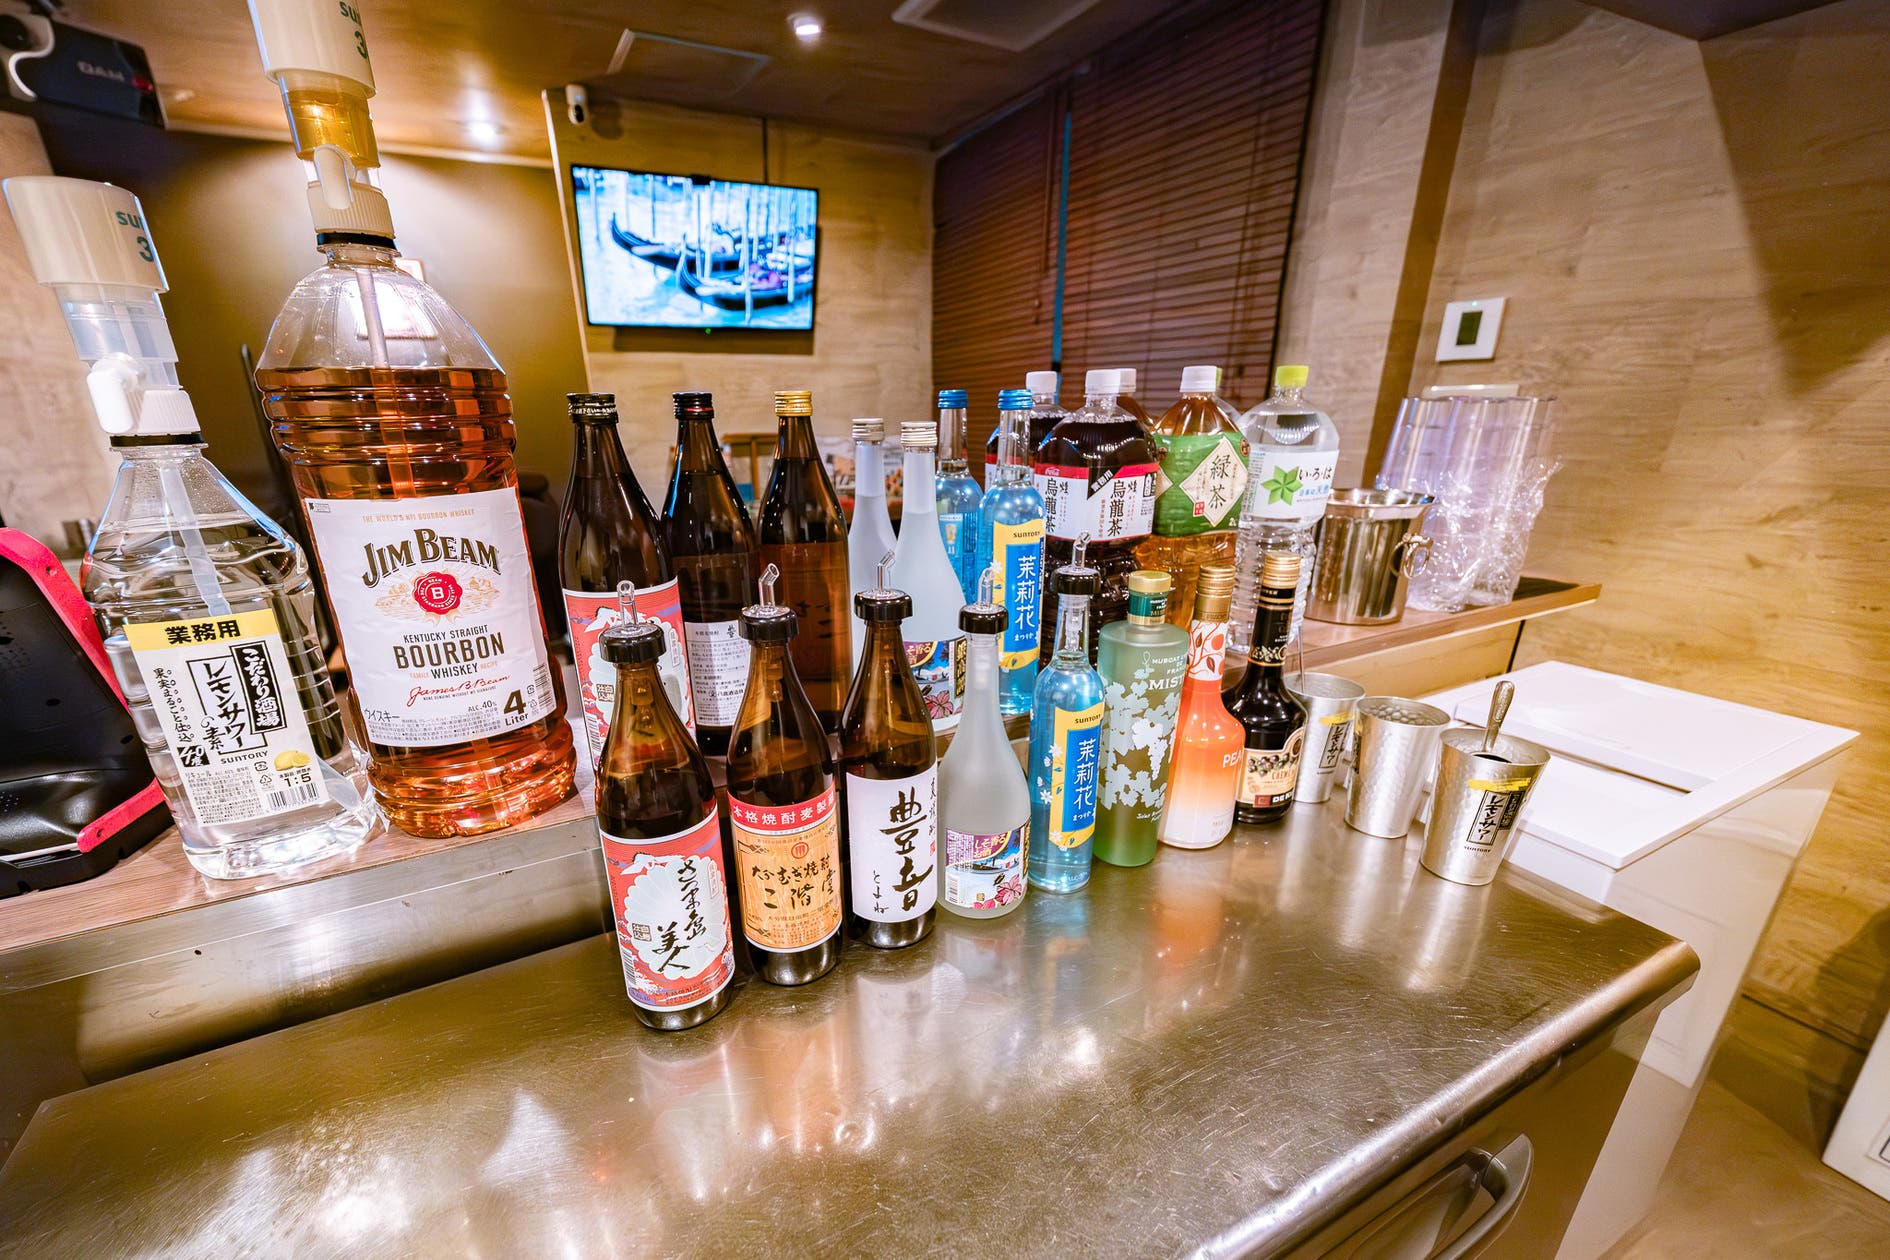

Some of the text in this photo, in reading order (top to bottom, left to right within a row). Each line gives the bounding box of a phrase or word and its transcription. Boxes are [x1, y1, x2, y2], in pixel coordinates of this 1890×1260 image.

[1208, 453, 1232, 509] 緑茶
[1107, 479, 1127, 537] 烏龍茶
[362, 528, 502, 588] JIM BEAM
[1014, 554, 1037, 629] 茉莉花
[164, 618, 241, 645] 業務用
[393, 631, 505, 670] BOURBON
[403, 624, 489, 644] KENTUCKY STRAIGHT
[241, 647, 281, 728] こだわり酒場
[431, 662, 479, 680] WHISKEY
[202, 660, 246, 748] レモンサワー
[364, 708, 400, 723] ウイスキー
[503, 689, 527, 716] 4
[504, 711, 529, 727] Liter
[220, 750, 269, 765] SUNTORY
[1074, 738, 1097, 811] 茉莉花
[1478, 795, 1506, 841] レモンサワー
